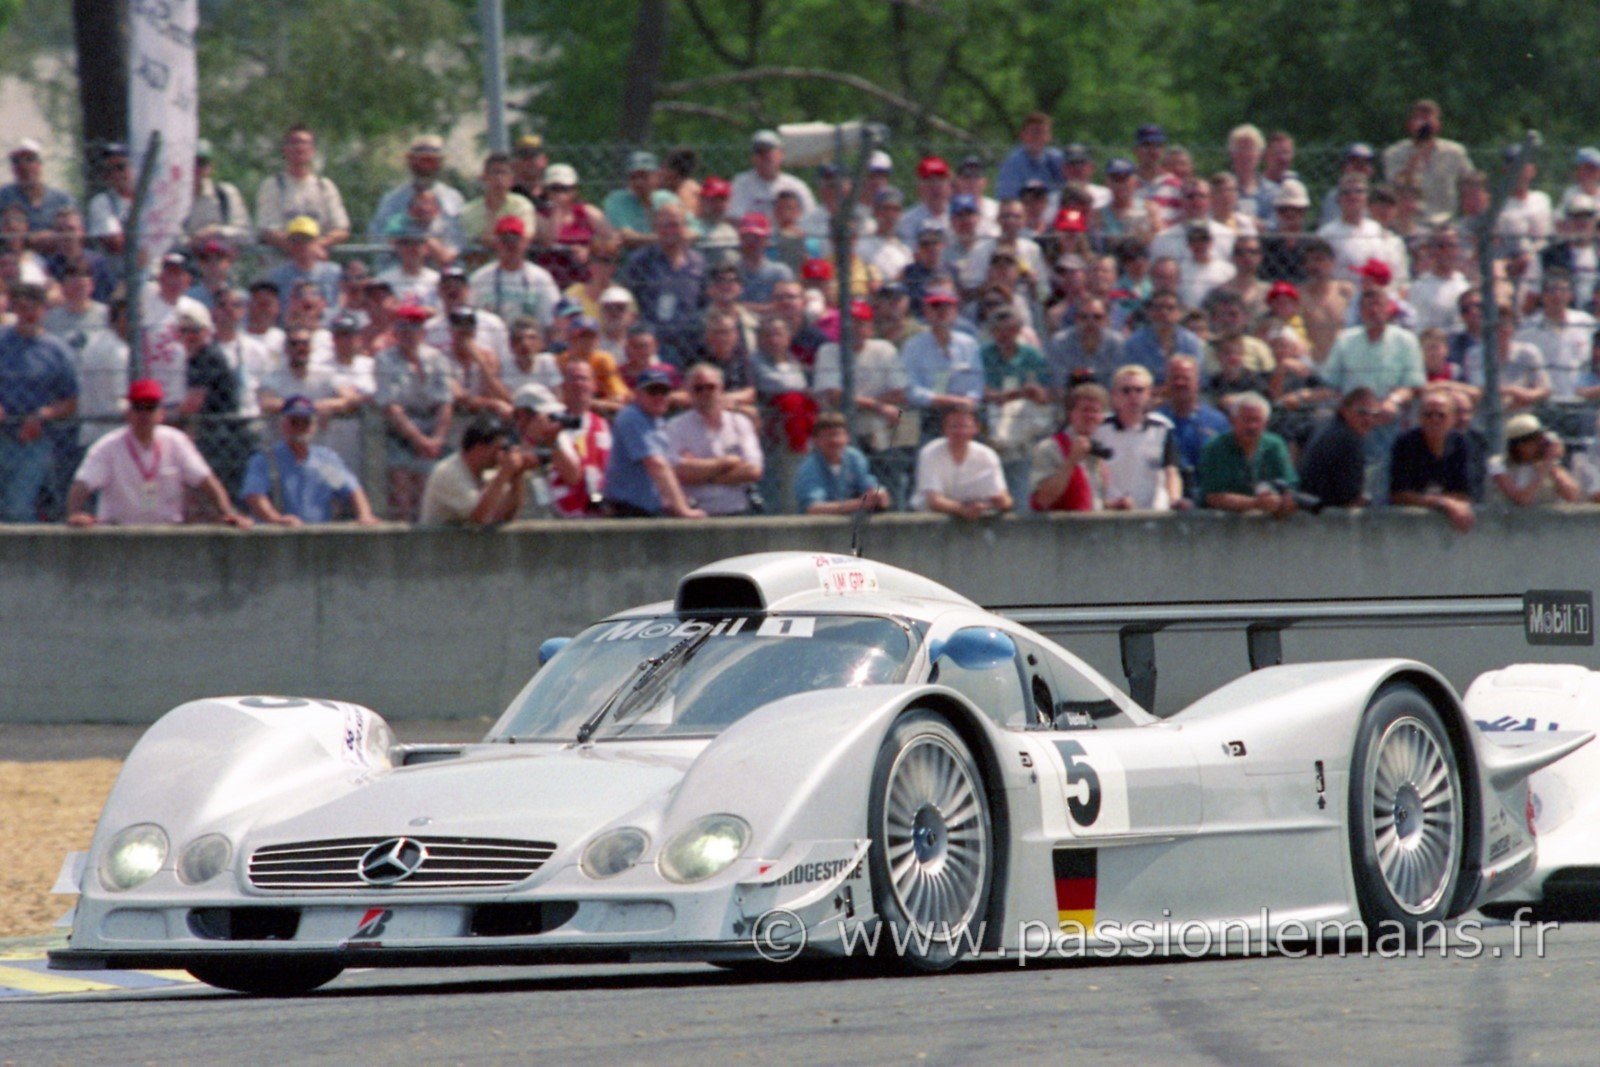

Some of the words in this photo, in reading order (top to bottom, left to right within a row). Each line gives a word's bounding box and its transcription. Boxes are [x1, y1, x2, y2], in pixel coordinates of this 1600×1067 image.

[593, 617, 748, 643] Mobil
[1529, 603, 1571, 634] Mobil
[1051, 739, 1102, 828] 5
